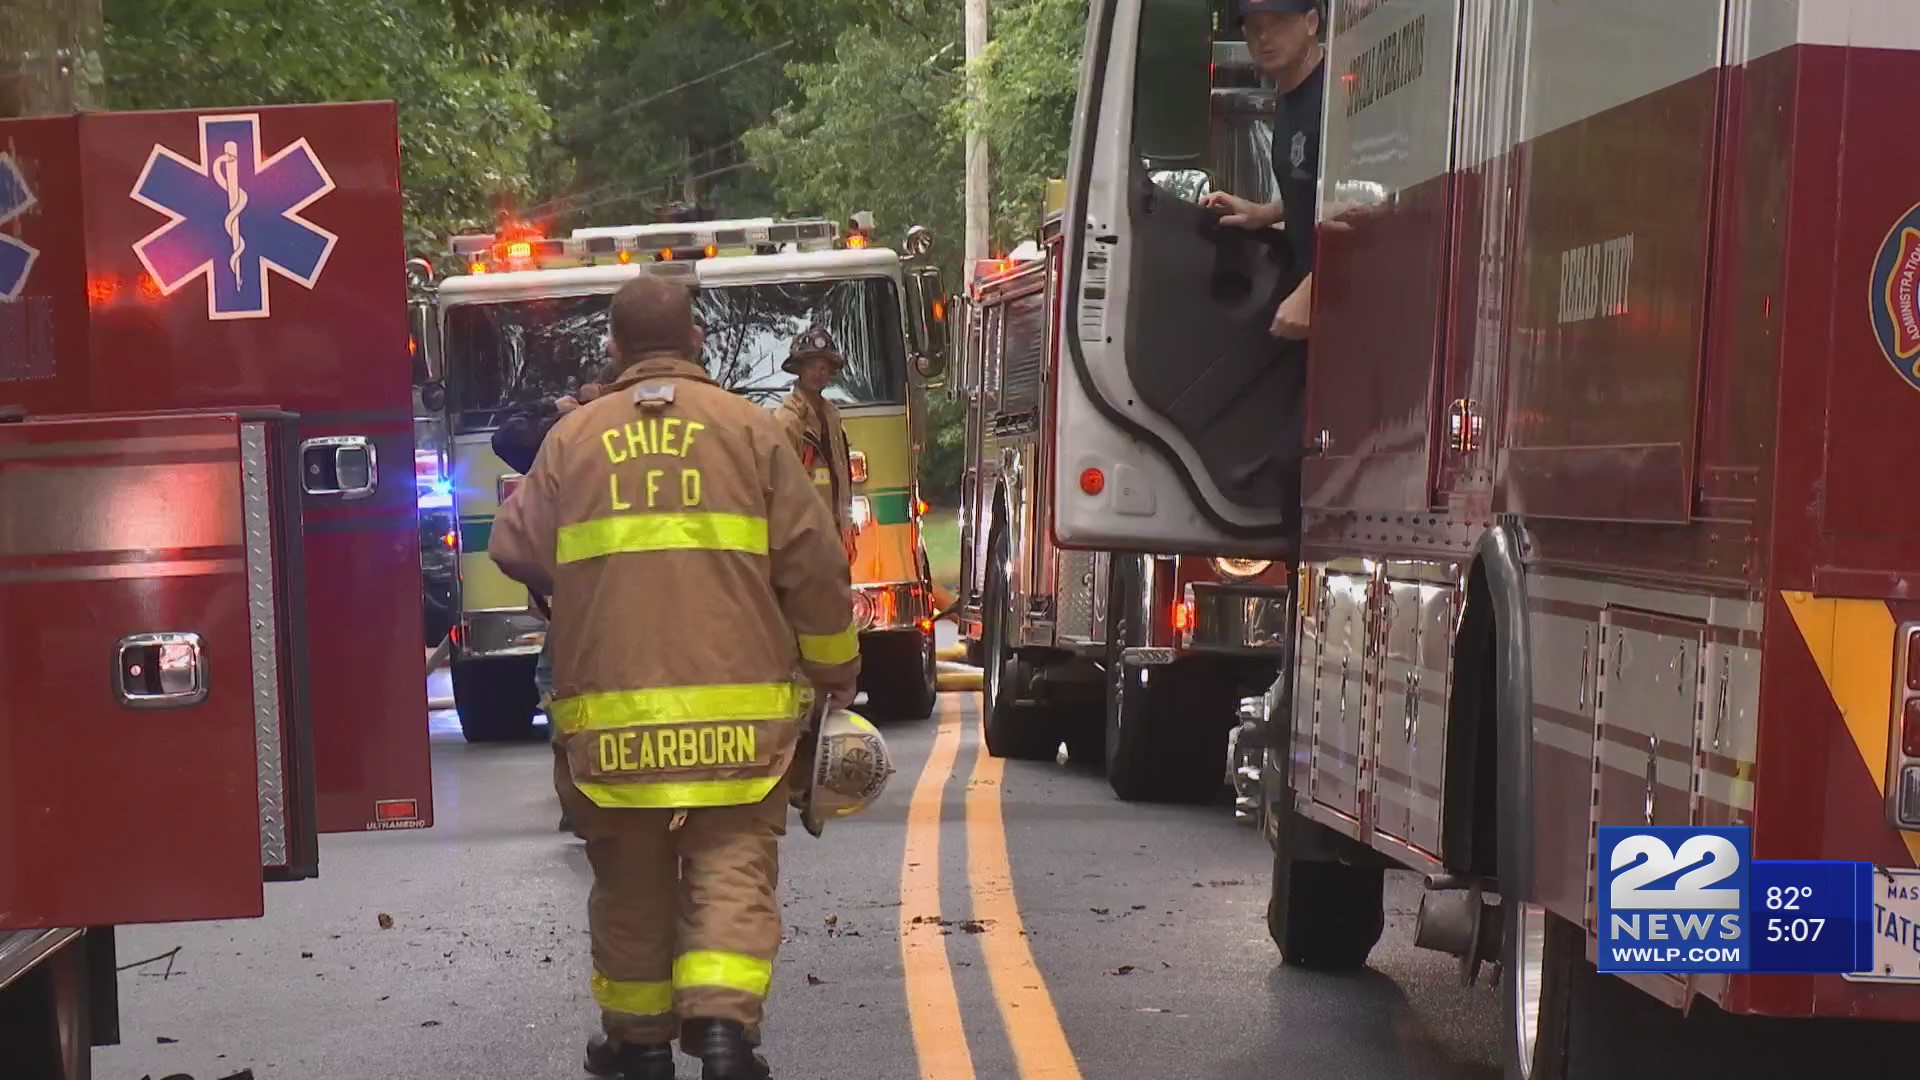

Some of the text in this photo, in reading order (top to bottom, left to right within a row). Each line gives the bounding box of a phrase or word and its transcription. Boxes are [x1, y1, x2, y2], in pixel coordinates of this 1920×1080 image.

[1375, 13, 1425, 101] OPERATIONS
[1558, 231, 1634, 324] REHAB UNIT
[602, 417, 705, 464] CHIEF
[600, 724, 756, 772] DEARBORN
[1887, 885, 1920, 901] MAS
[1874, 903, 1920, 954] TATE
